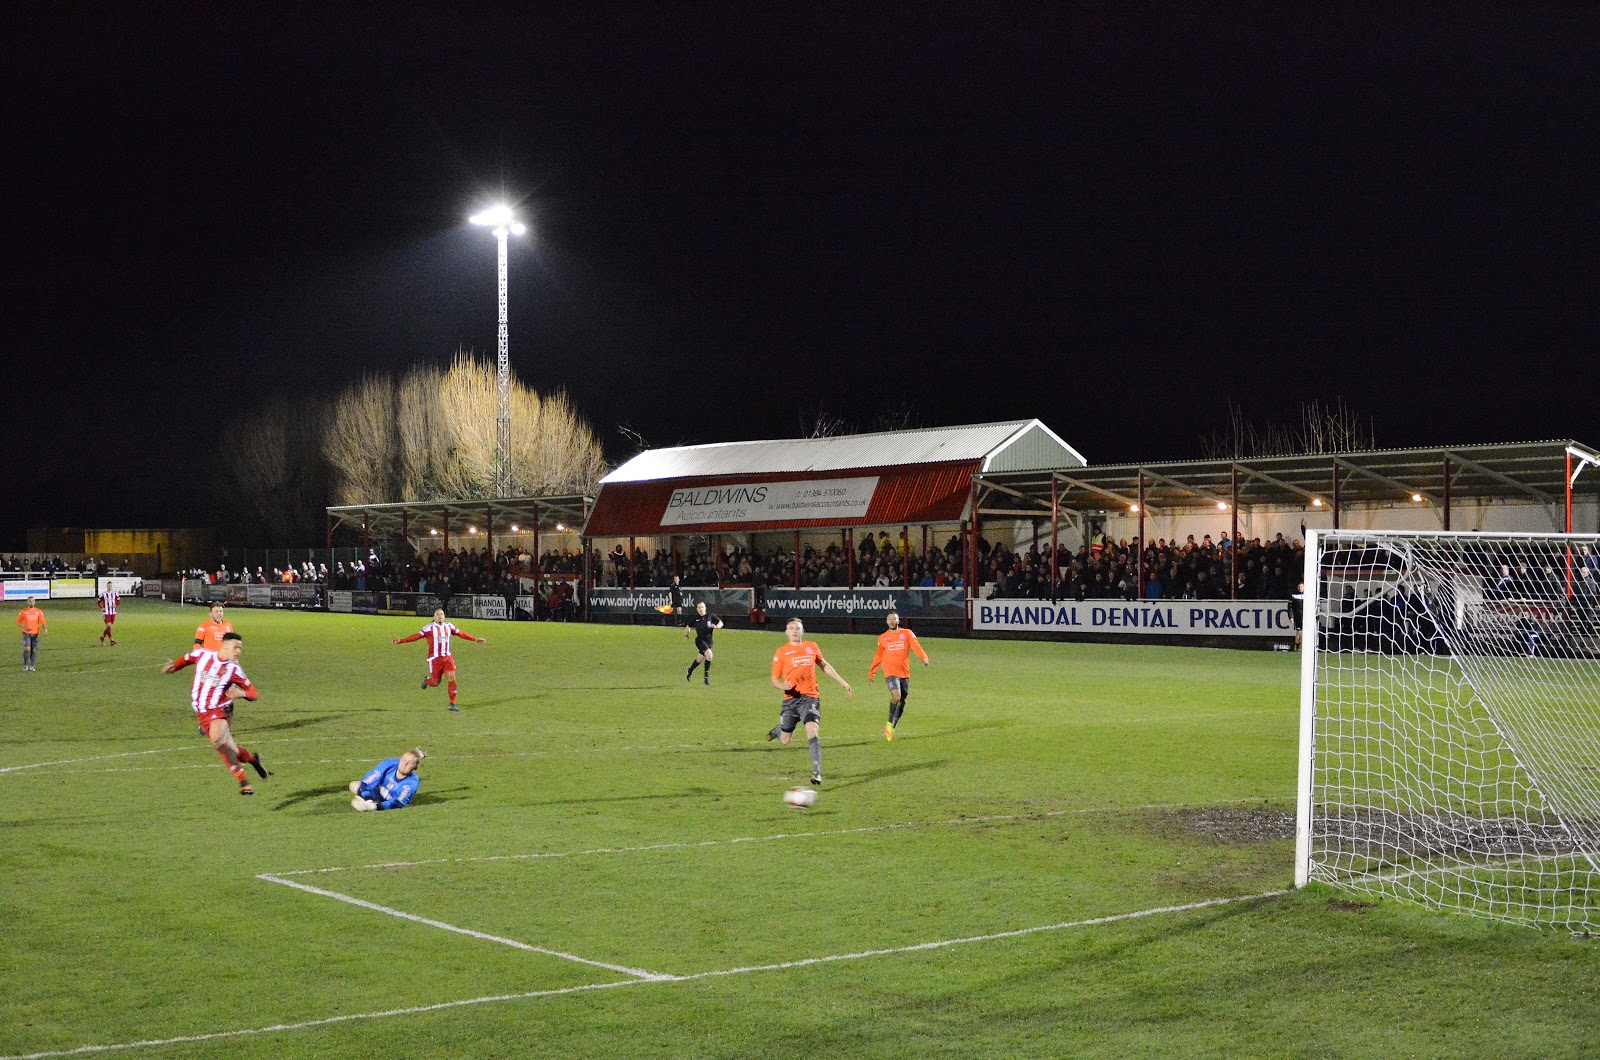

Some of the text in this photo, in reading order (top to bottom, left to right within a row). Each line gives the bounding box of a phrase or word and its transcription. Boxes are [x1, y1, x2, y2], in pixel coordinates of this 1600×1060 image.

[669, 486, 768, 508] BALDWINS
[775, 499, 867, 510] www.baldwinsaccountants.co.uk
[675, 507, 748, 521] Accountants
[474, 599, 505, 608] BHANDAL
[590, 593, 695, 612] www.andyfreight.uk
[766, 591, 897, 613] www.andyfreight.co.uk
[980, 605, 1291, 630] BHANDAL DENTAL PRACTIC
